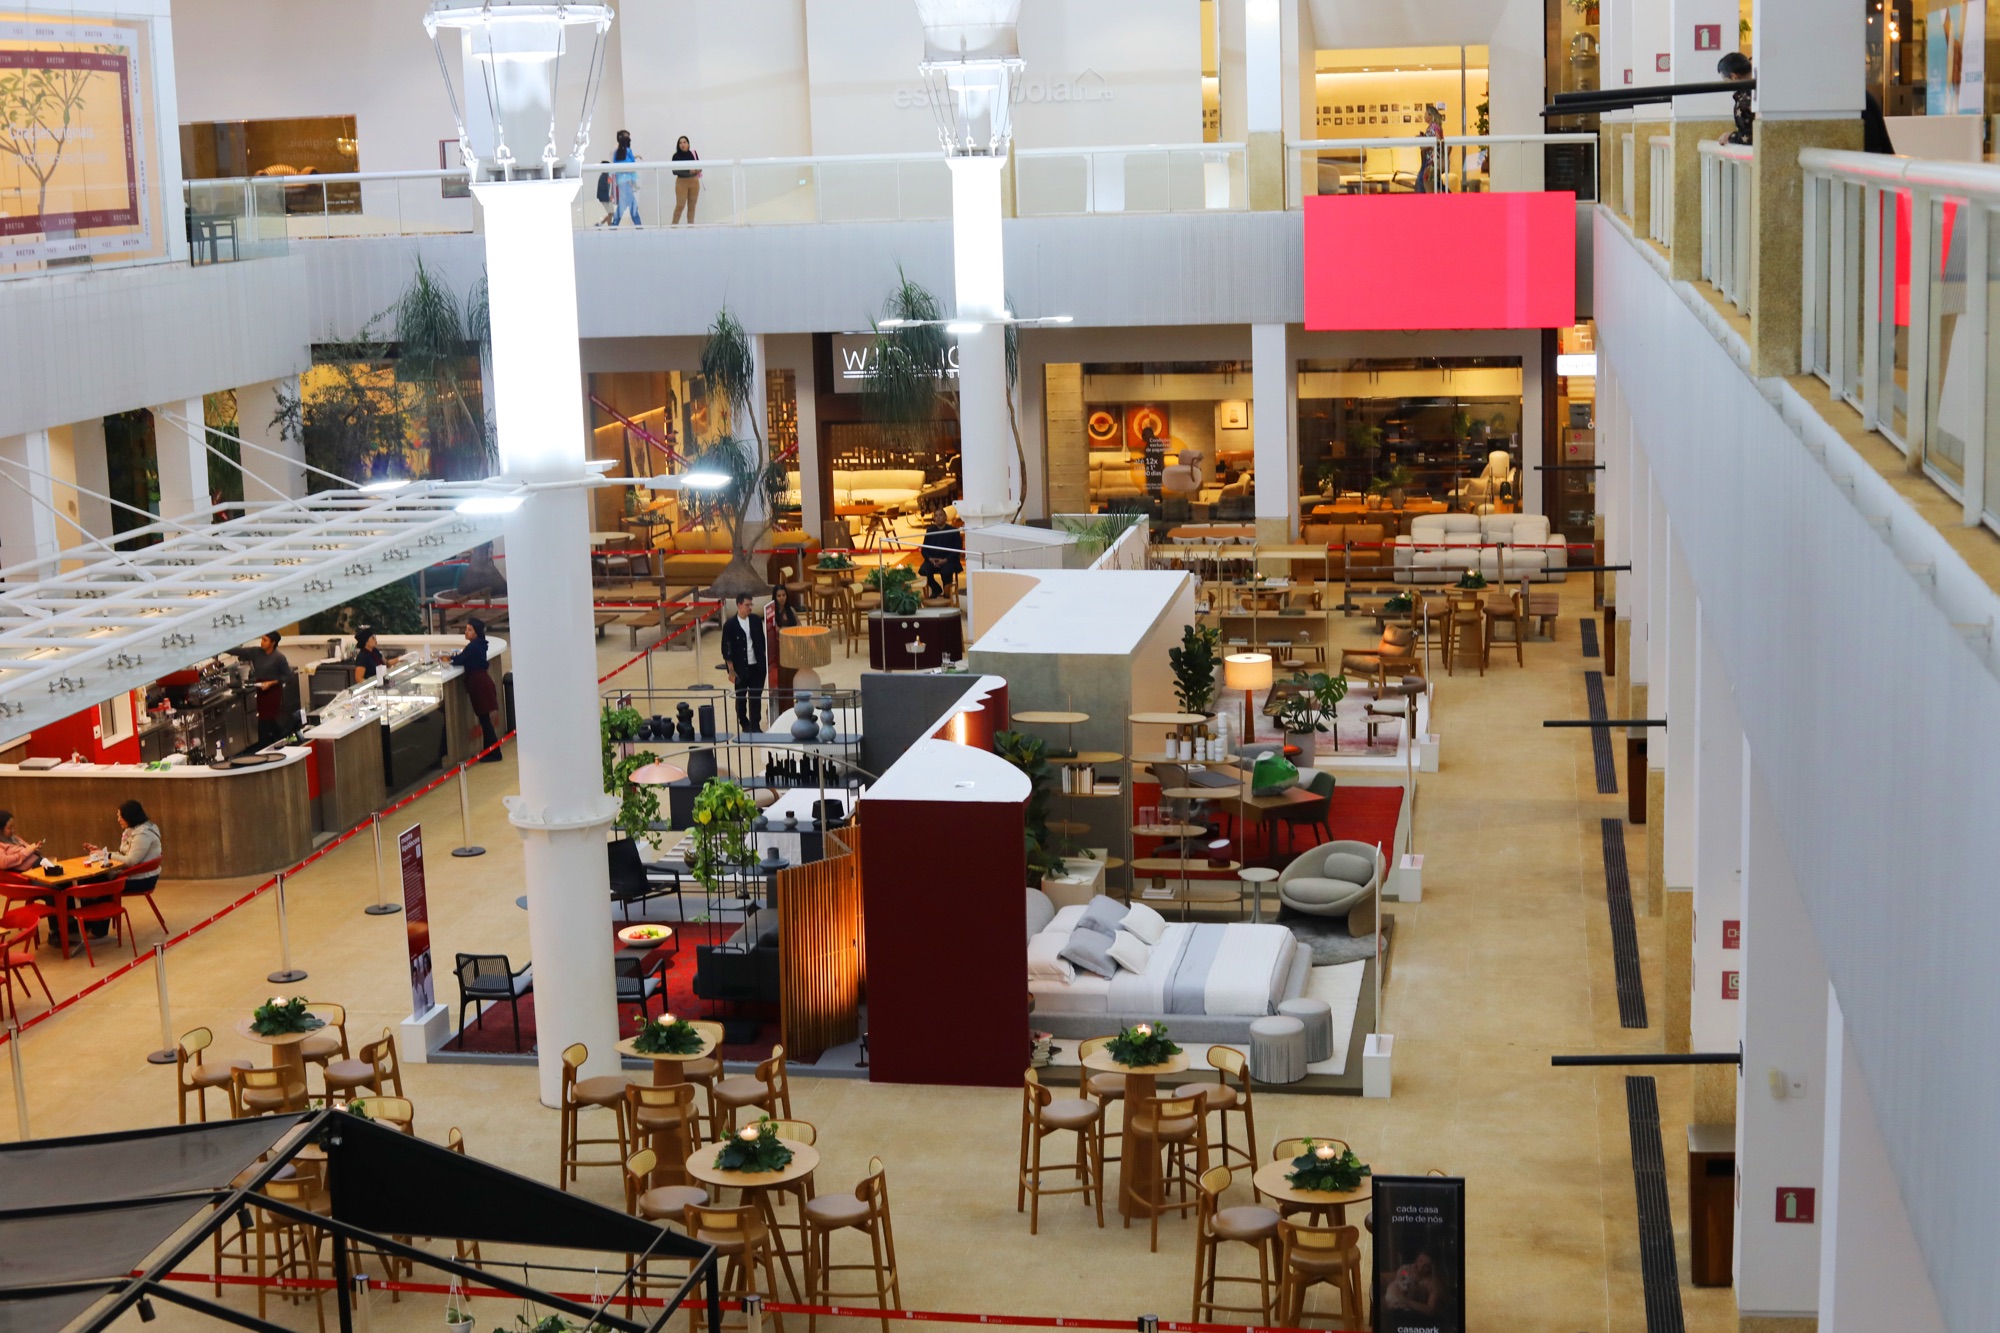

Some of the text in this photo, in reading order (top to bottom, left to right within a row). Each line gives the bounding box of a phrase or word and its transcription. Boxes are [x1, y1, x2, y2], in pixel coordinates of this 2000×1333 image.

[46, 56, 65, 64] BRETON
[101, 59, 120, 68] BRETON
[5, 221, 24, 230] BRETON
[58, 217, 77, 226] BRETON
[113, 213, 131, 222] BRETON
[16, 249, 35, 257] BRETON
[69, 244, 87, 252] BRETON
[122, 238, 140, 246] BRETON
[1396, 1205, 1417, 1213] cada
[1392, 1214, 1444, 1224] parte de nós
